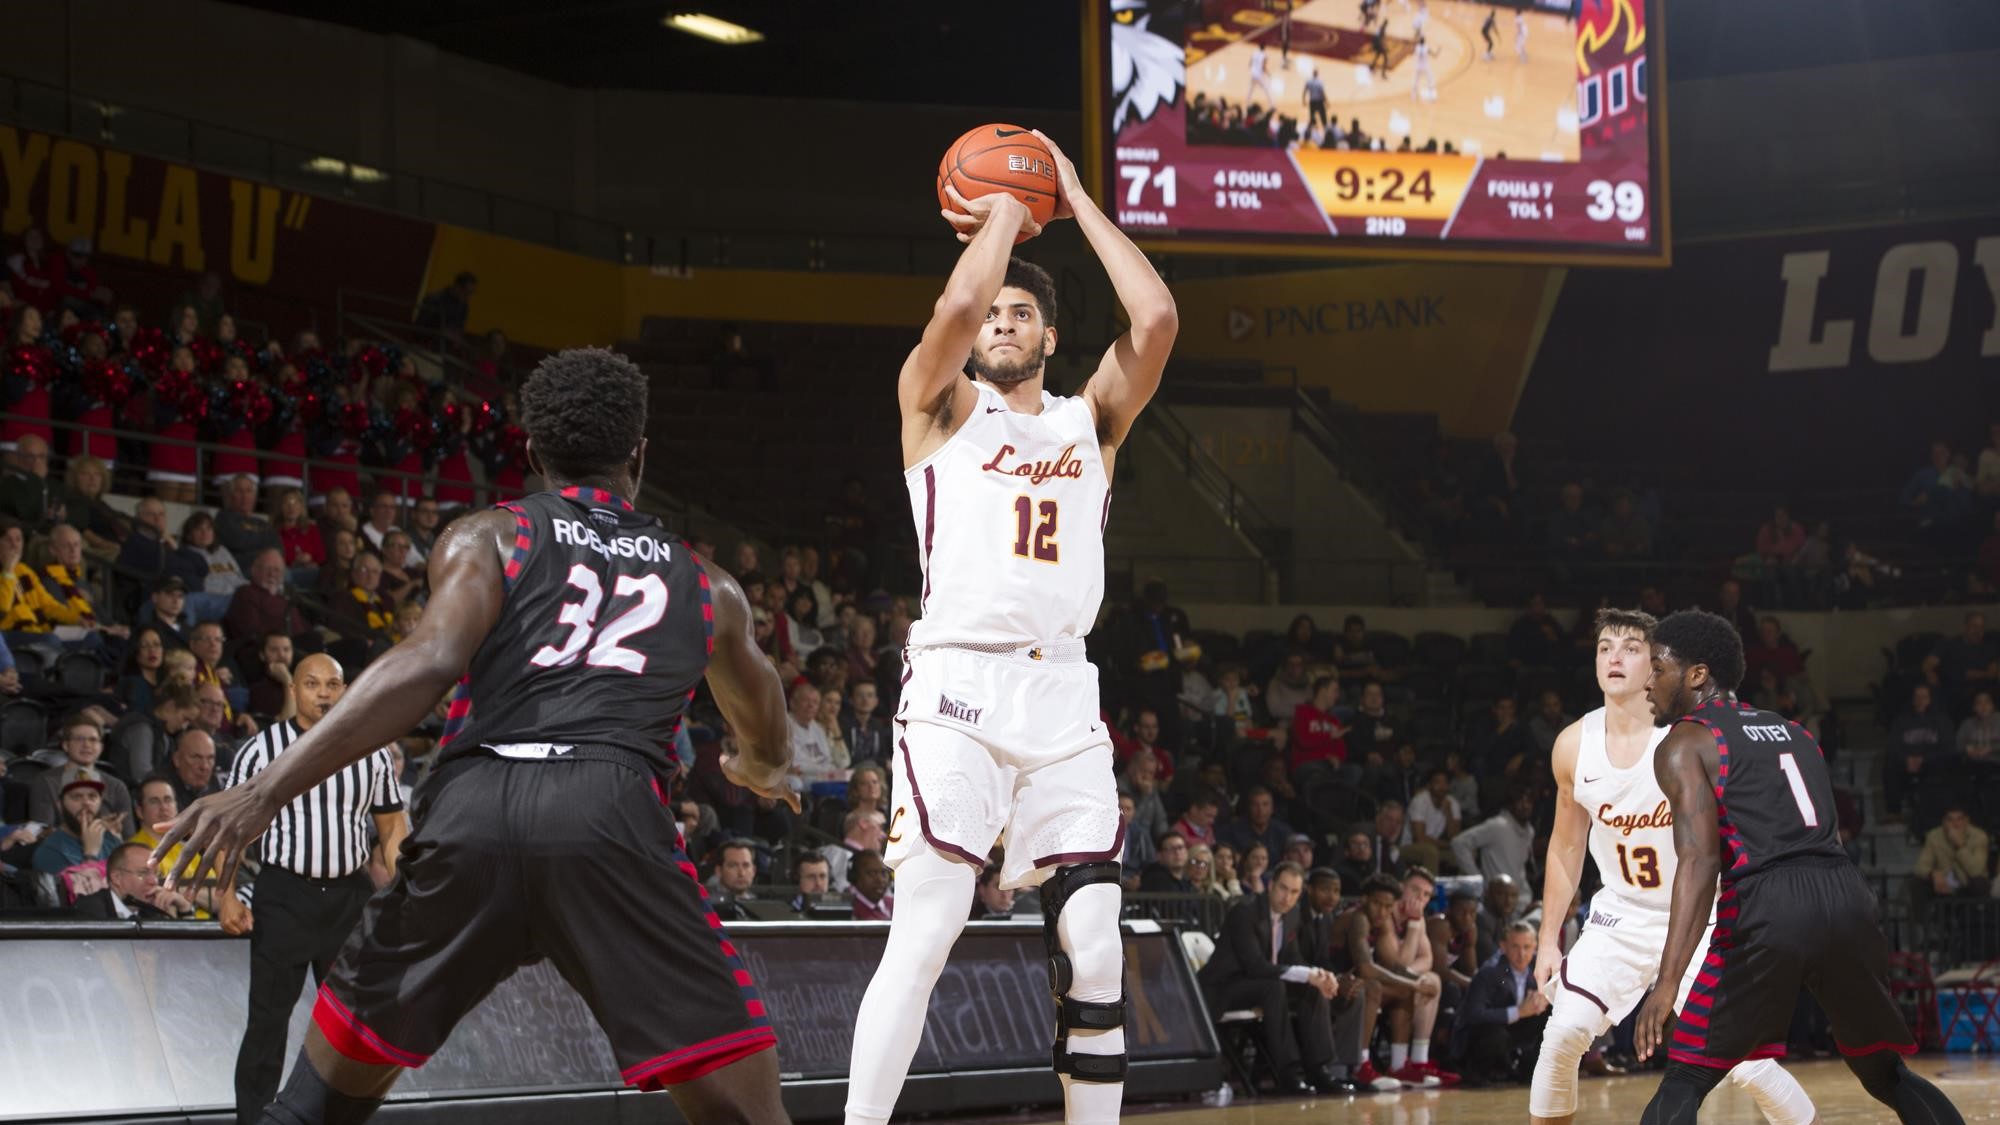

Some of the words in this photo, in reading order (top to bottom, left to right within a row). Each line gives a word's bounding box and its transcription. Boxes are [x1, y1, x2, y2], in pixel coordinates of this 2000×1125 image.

[1120, 165, 1176, 208] 71
[1214, 170, 1226, 187] 4
[1228, 170, 1282, 189] FOULS
[1335, 167, 1435, 203] 9:24
[1487, 180, 1540, 199] FOULS
[1542, 182, 1554, 199] 7
[1118, 211, 1168, 225] LOYOLA
[1228, 191, 1262, 209] TOL
[1508, 202, 1541, 219] TOL
[1544, 203, 1554, 219] 1
[1586, 180, 1645, 222] 39
[1365, 216, 1406, 236] 2ND
[1264, 303, 1340, 337] PNC
[1346, 295, 1447, 331] BANK
[981, 442, 1083, 486] Loyla
[552, 518, 671, 563] ROBNSON
[1012, 494, 1060, 564] 12
[529, 563, 669, 674] 32
[939, 693, 983, 724] VALLEY
[1742, 724, 1792, 742] OTTEY
[1779, 752, 1818, 828] 1
[1598, 799, 1673, 836] Loyola
[1615, 842, 1662, 890] 13
